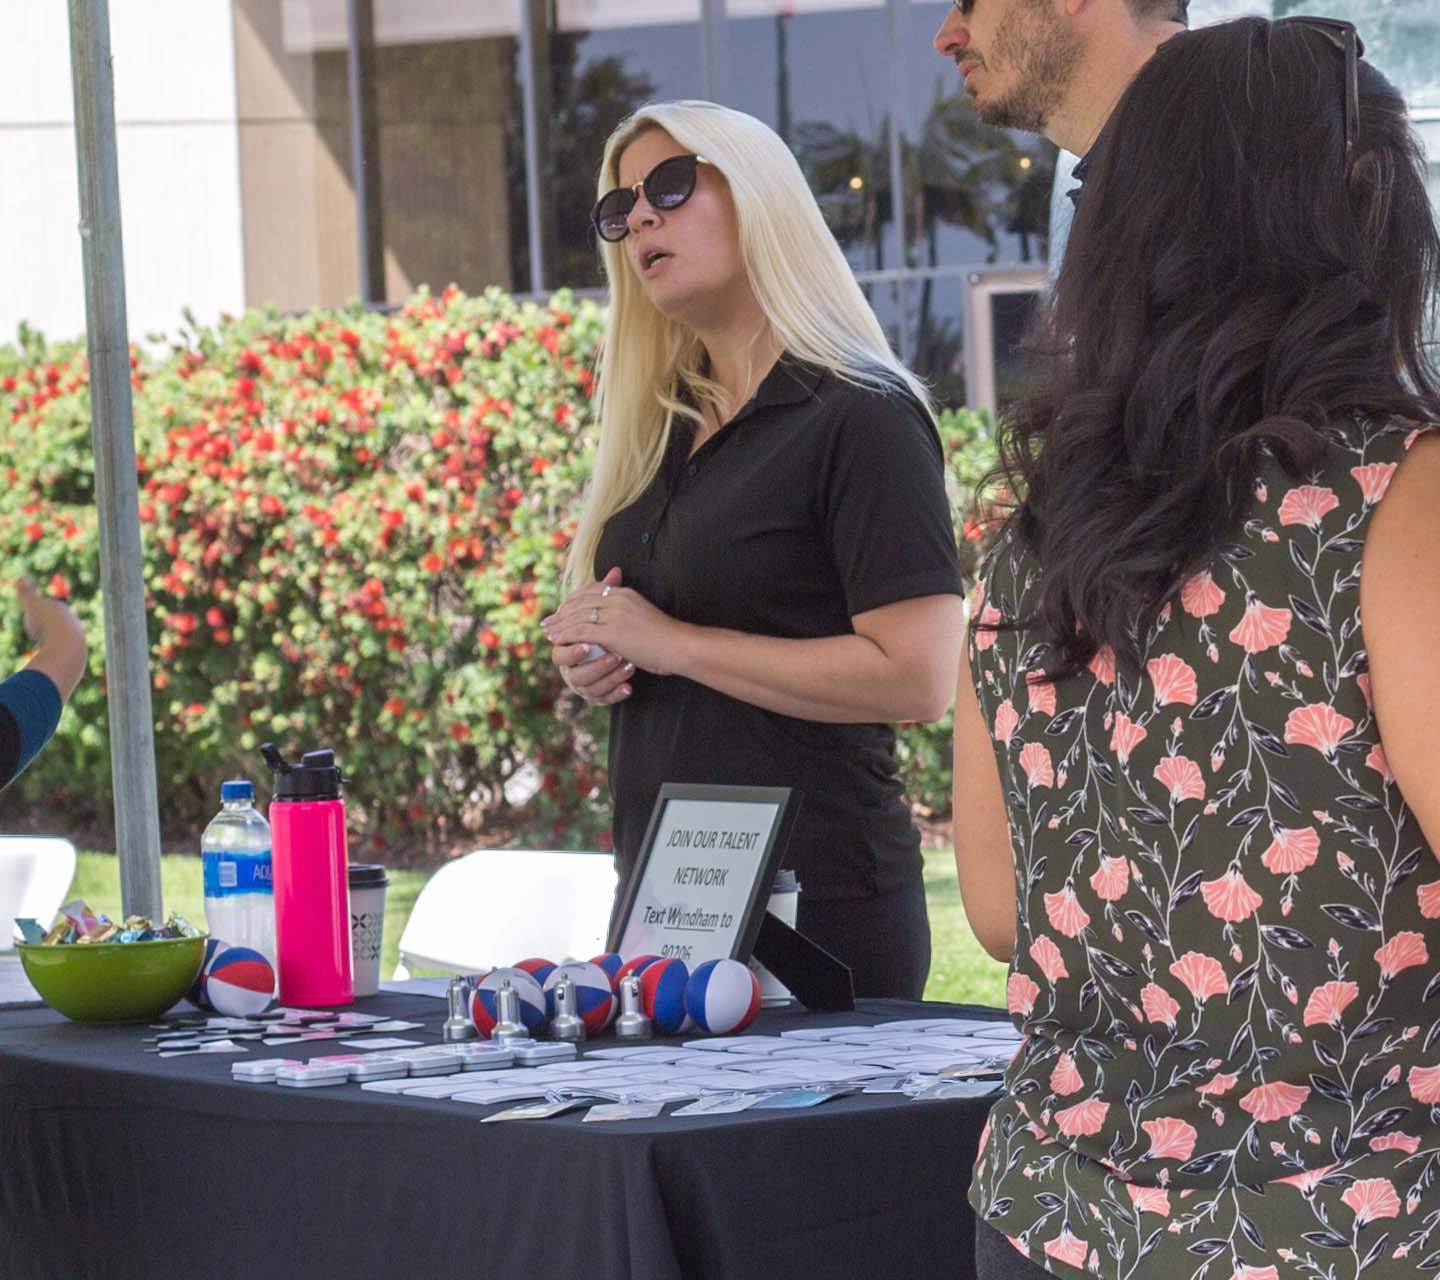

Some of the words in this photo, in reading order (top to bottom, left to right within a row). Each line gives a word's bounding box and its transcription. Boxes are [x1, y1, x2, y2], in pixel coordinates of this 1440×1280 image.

[666, 829, 691, 848] JOIN
[693, 830, 717, 849] OUR
[718, 831, 760, 851] TALENT
[672, 867, 730, 887] NETWORK
[643, 906, 668, 925] Text
[667, 907, 716, 928] Wyndham
[719, 913, 734, 928] to
